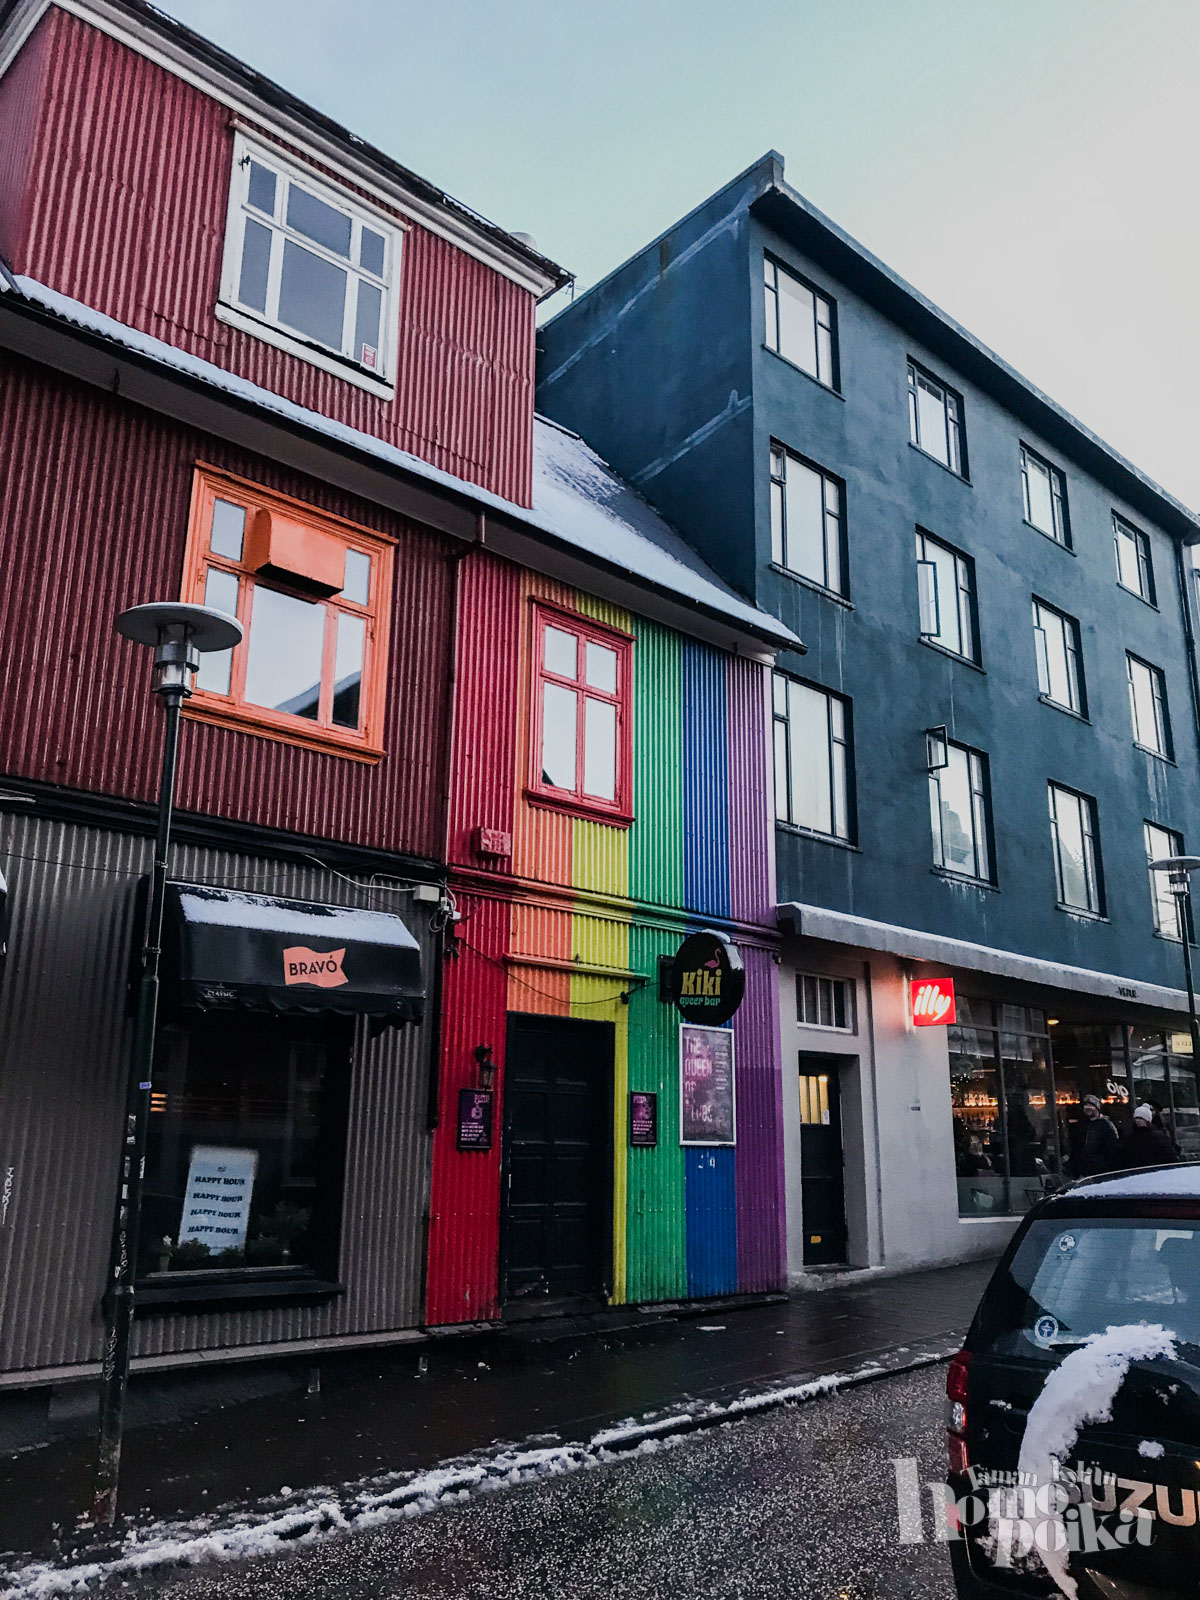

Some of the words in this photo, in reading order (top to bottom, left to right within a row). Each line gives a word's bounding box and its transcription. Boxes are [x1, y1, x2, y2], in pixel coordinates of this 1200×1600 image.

[289, 955, 338, 976] BRAVÓ
[681, 969, 722, 996] Kiki
[680, 997, 703, 1008] queer
[704, 996, 720, 1006] bar
[914, 984, 951, 1021] illy
[195, 1176, 221, 1185] HAPPY
[223, 1178, 245, 1186] HOUR
[193, 1193, 220, 1201] HAPPY
[190, 1209, 217, 1217] HAPPY
[188, 1225, 214, 1233] HAPPY
